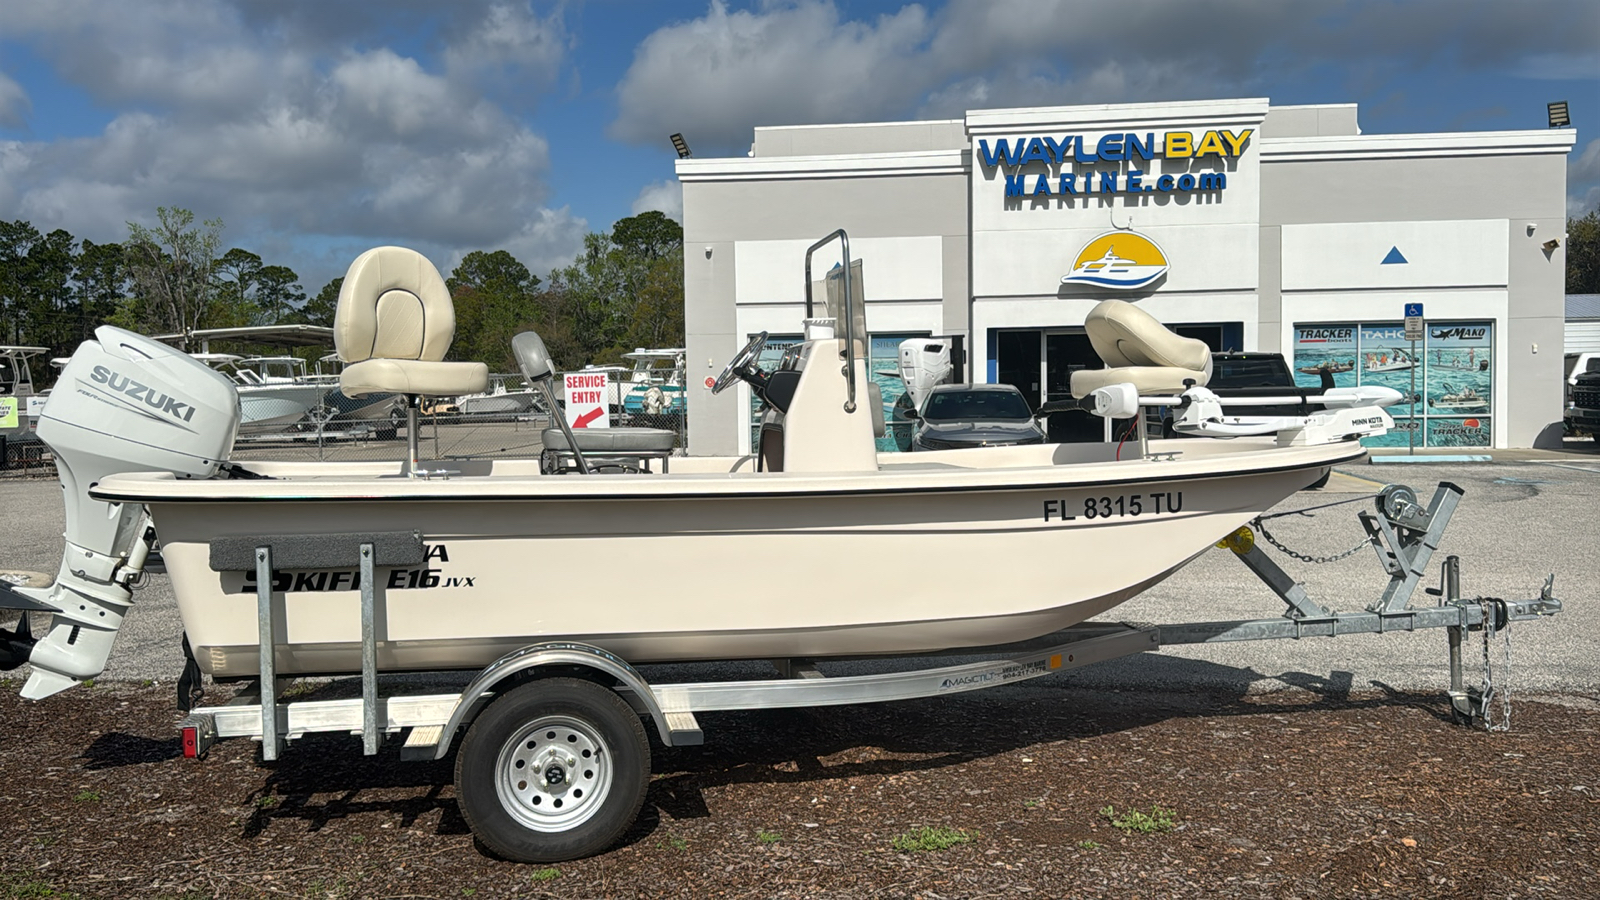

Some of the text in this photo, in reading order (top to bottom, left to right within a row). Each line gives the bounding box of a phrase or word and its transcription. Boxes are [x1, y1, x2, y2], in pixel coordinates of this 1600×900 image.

[979, 128, 1256, 166] WAYLEN BAY
[1005, 170, 1227, 198] MARINE.com
[1299, 328, 1352, 339] TRACKER
[1450, 327, 1486, 340] MAKO
[566, 375, 606, 389] SERVICE
[90, 365, 196, 423] SUZUKI
[572, 391, 601, 404] ENTRY
[1351, 416, 1383, 427] MINN KOTA
[1432, 427, 1482, 435] TRACKER
[1043, 491, 1183, 522] FL 8315 TU
[386, 569, 442, 590] E16
[441, 576, 477, 588] JVX
